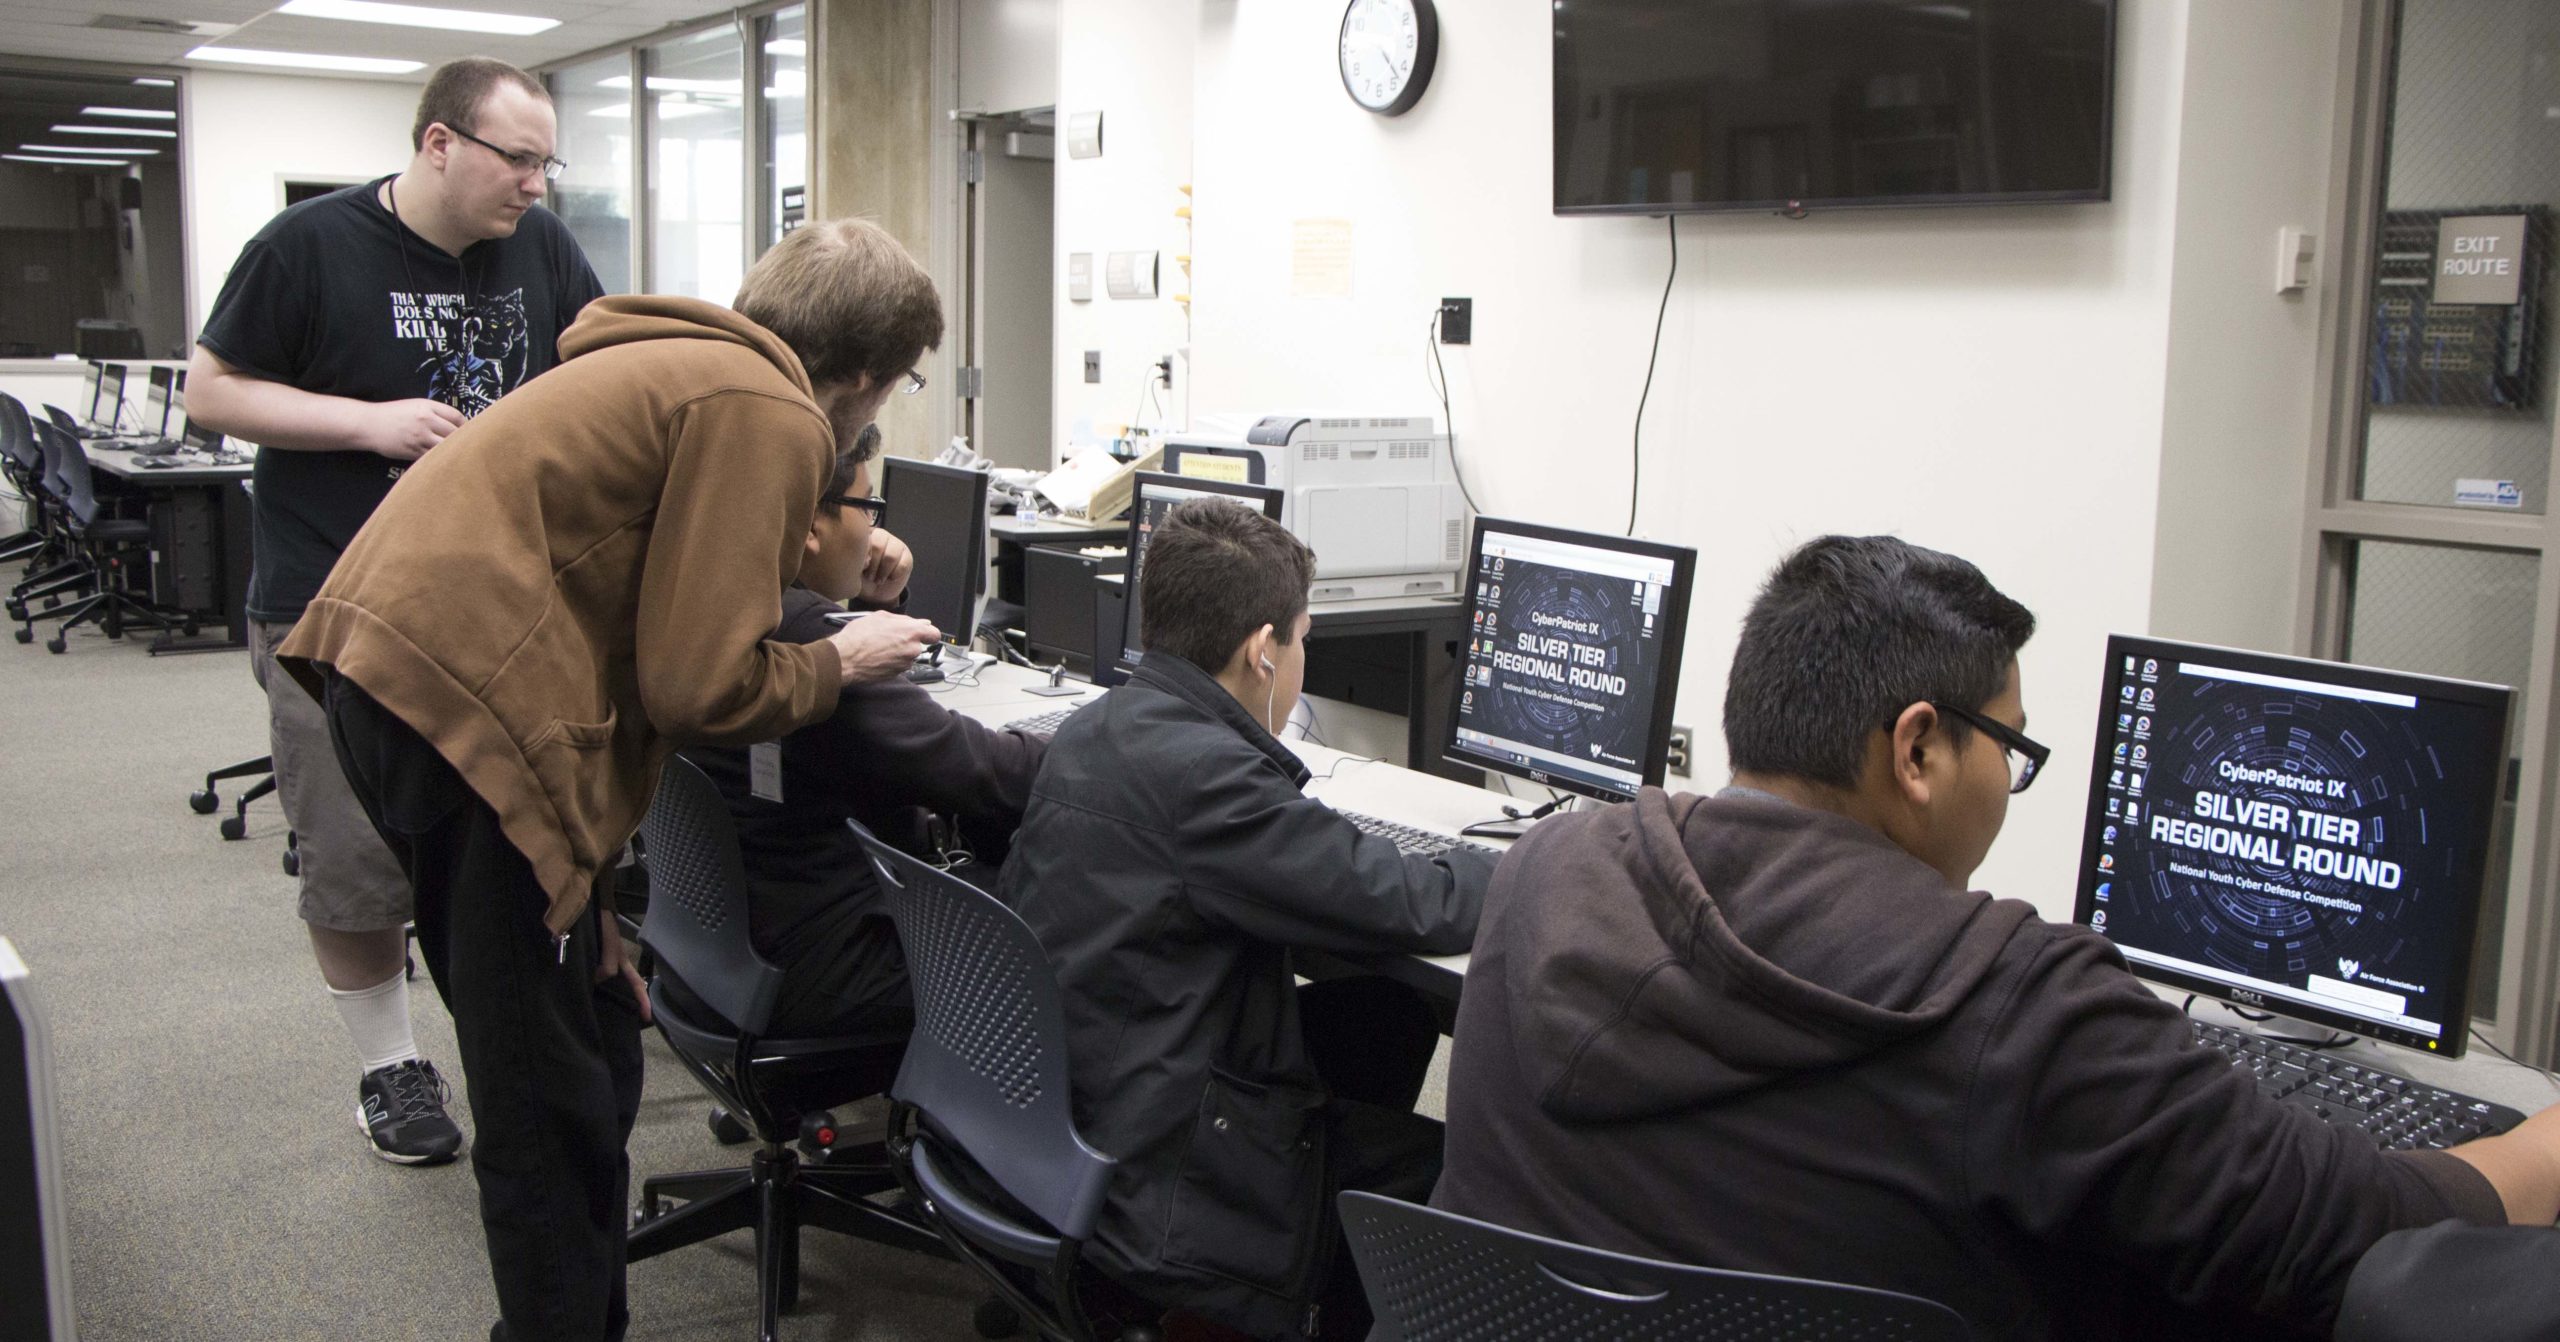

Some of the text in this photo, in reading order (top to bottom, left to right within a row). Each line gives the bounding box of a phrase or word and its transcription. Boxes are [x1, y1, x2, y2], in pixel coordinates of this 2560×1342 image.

[1407, 34, 1414, 48] 3
[2453, 236, 2500, 254] EXIT
[2443, 258, 2511, 276] ROUTE
[439, 307, 464, 320] NO
[395, 319, 447, 338] KILL
[1531, 611, 1600, 635] CyberPatriot IX
[1518, 632, 1606, 668] SILVER TIER
[1493, 650, 1626, 696] REGIONAL ROUND
[1502, 682, 1605, 712] National Youth Cyber Defense Competition
[2219, 760, 2347, 798] CyberPatriot IX
[2194, 791, 2360, 847] SILVER TIER
[2151, 814, 2402, 890] REGIONAL ROUND
[2169, 862, 2362, 913] National Youth Cyber Defense Competition
[2231, 987, 2265, 1007] DELL
